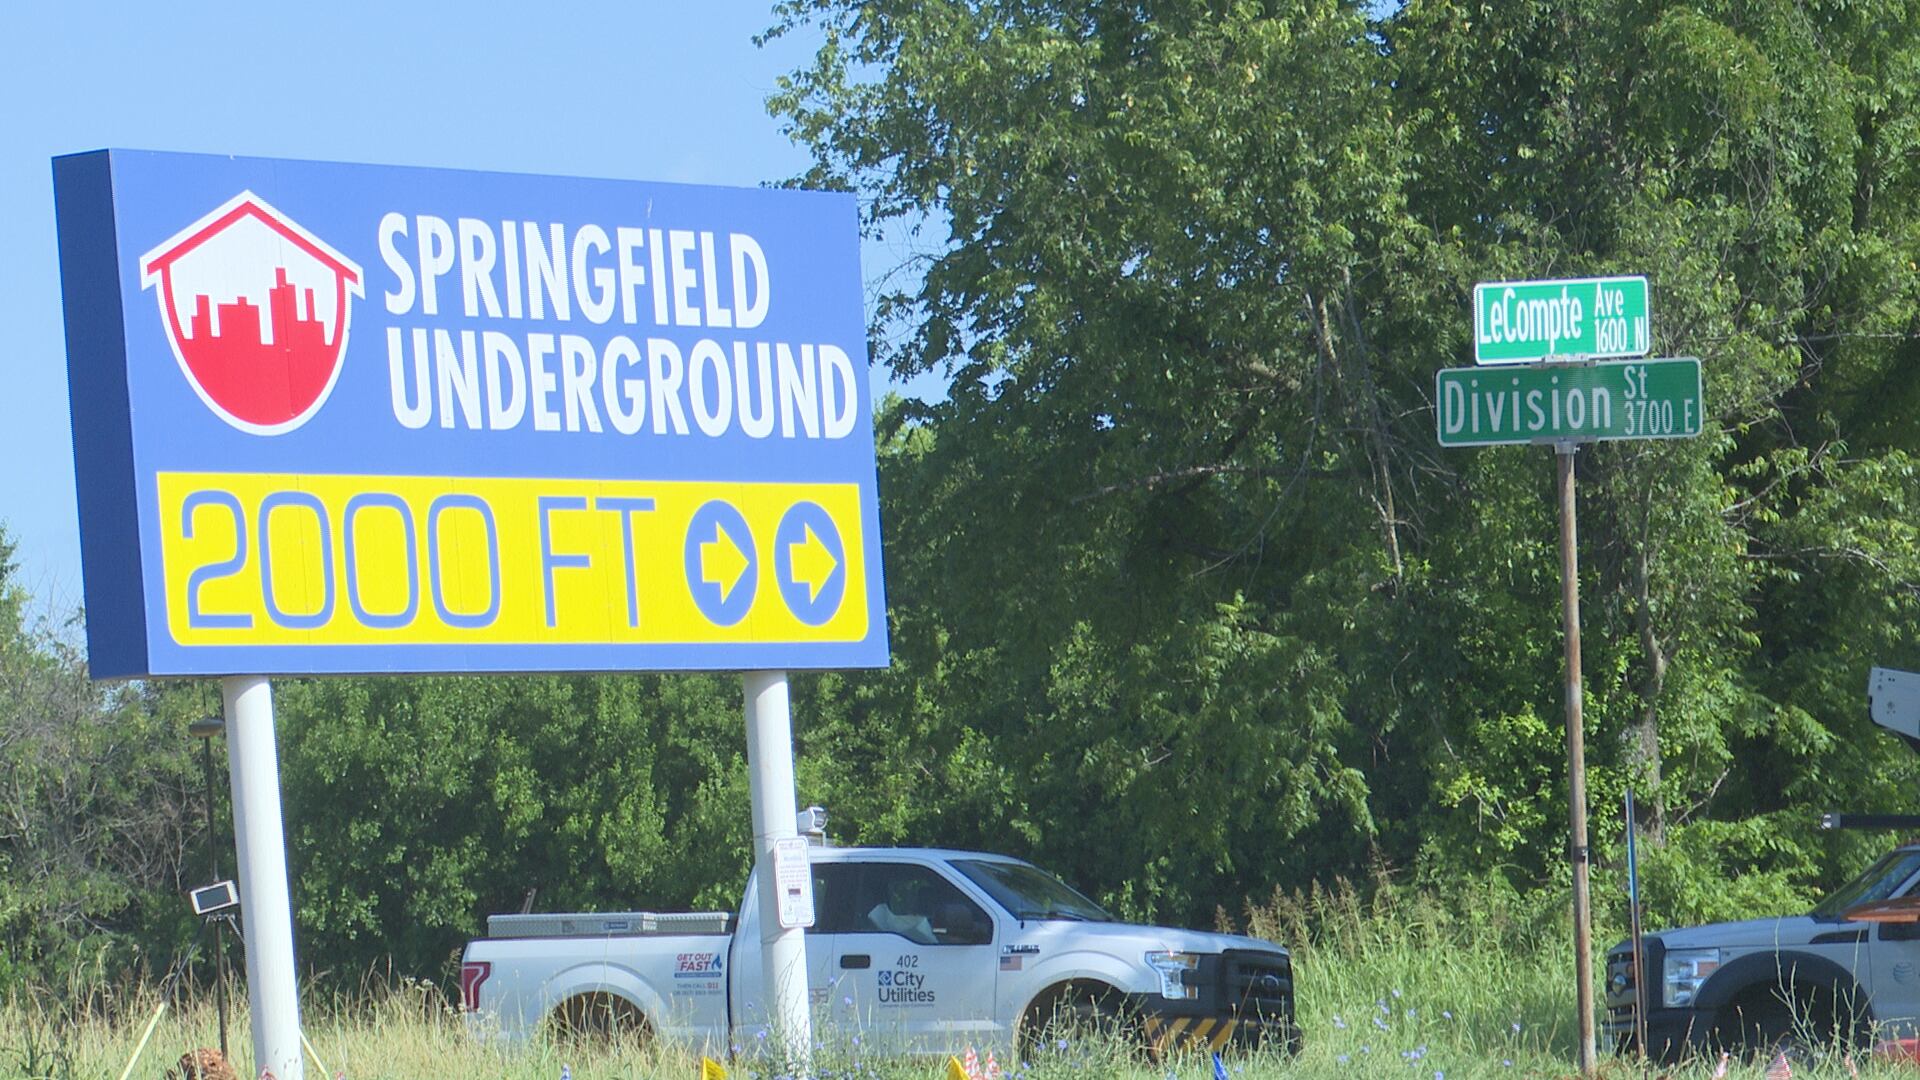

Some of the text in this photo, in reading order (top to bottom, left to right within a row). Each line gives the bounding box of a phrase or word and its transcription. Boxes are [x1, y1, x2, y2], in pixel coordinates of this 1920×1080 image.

[378, 211, 770, 329] SPRINGFIELD
[1478, 282, 1624, 355] LeCompte Ave
[1594, 316, 1645, 353] 1600 N
[386, 326, 858, 440] UNDERGROUND
[1444, 365, 1648, 435] Division St
[1624, 399, 1695, 435] 3700 E
[181, 489, 656, 630] 2000 FT
[676, 953, 712, 961] GET OUT
[679, 961, 711, 971] FAST
[896, 954, 919, 969] 402
[878, 987, 936, 1003] Utilities
[893, 970, 925, 989] City
